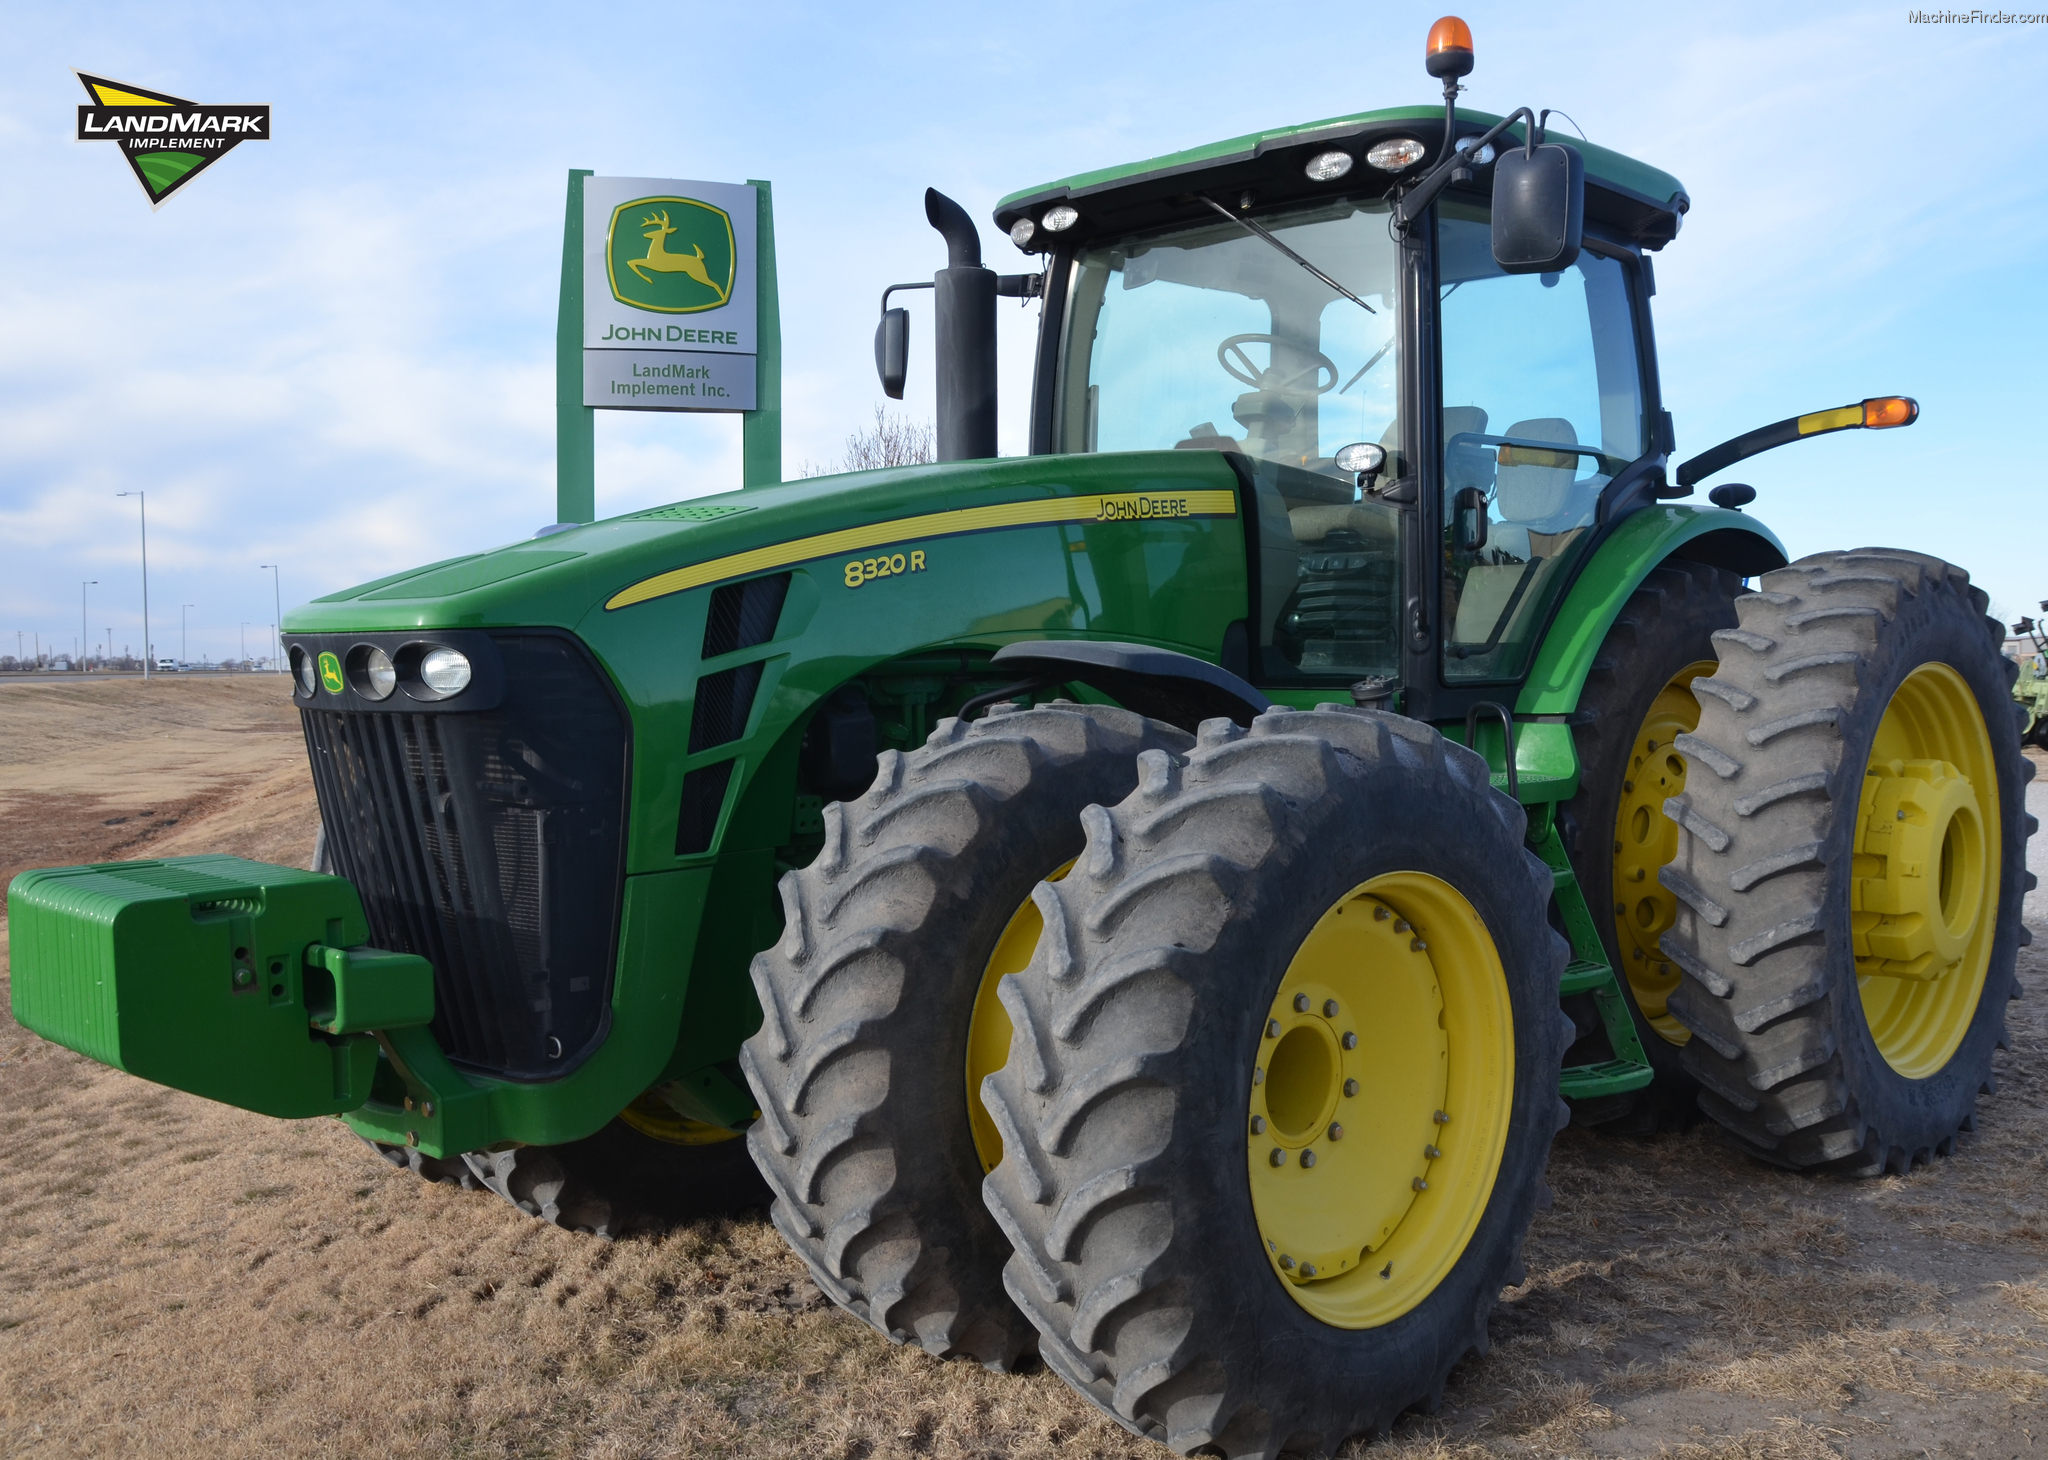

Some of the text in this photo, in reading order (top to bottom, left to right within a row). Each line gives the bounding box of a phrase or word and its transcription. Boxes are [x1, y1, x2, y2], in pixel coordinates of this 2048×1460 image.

[601, 323, 738, 345] JOHN DEERE
[632, 362, 711, 380] LandMark
[611, 380, 731, 398] Implement Inc.
[1096, 496, 1189, 520] JOHN DEERE
[844, 549, 928, 589] 8320 R
